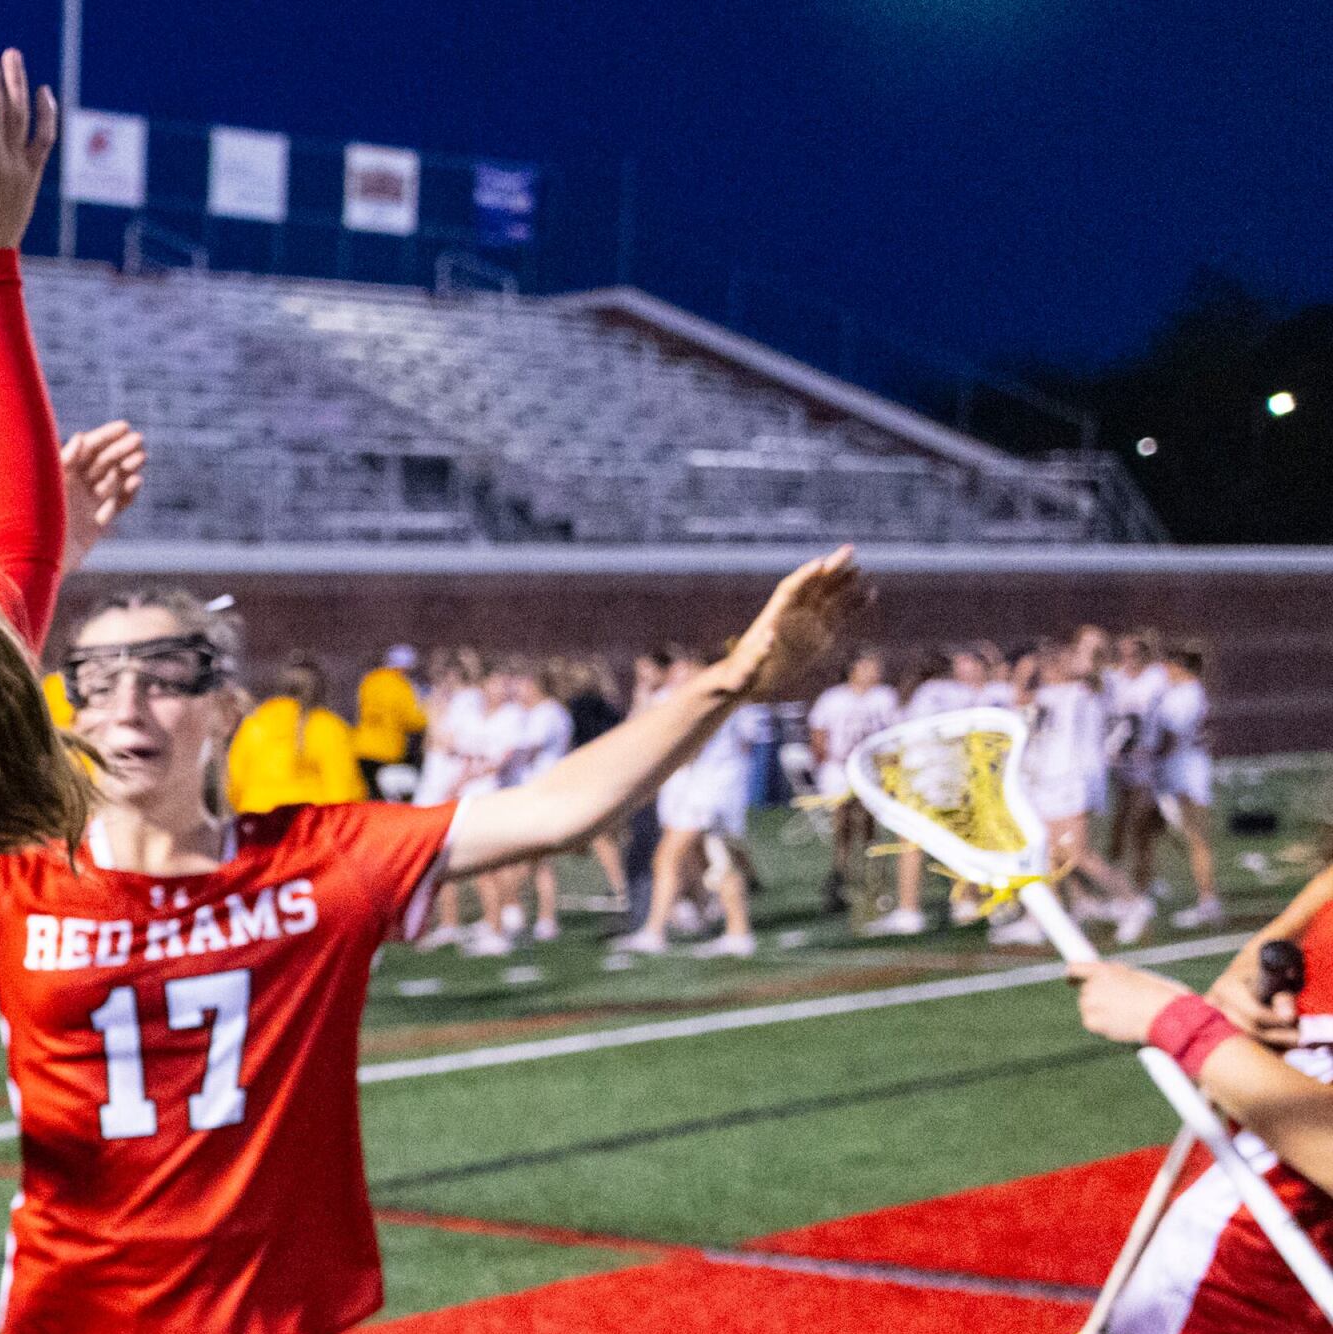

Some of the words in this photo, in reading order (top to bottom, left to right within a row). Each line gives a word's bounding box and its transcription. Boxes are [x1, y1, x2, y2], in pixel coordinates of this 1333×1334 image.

[23, 913, 132, 970] RED
[144, 878, 318, 961] RAMS
[90, 969, 251, 1140] 17
